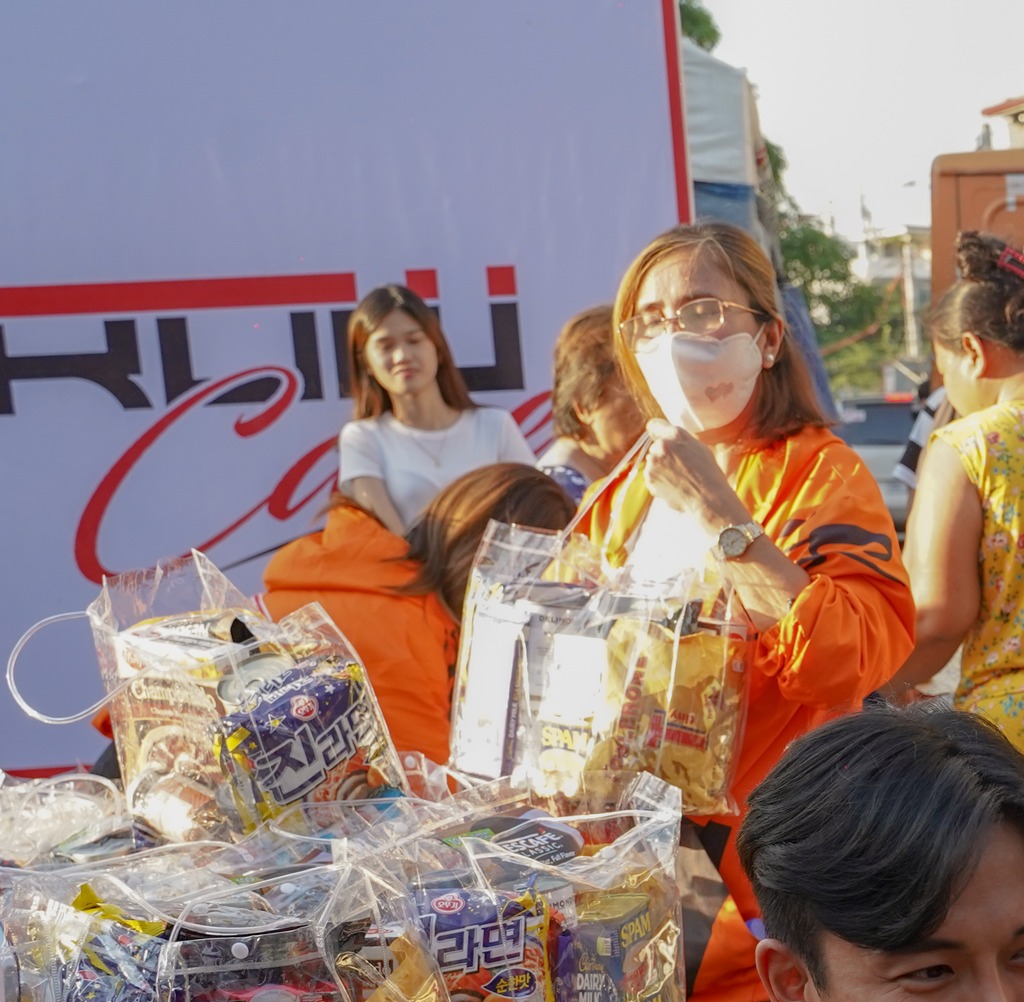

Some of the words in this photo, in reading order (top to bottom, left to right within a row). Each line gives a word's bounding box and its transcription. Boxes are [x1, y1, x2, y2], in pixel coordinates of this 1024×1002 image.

[541, 726, 588, 755] SPAM
[432, 915, 525, 974] 라면
[620, 912, 650, 949] SPAM
[576, 973, 605, 991] DAIRY
